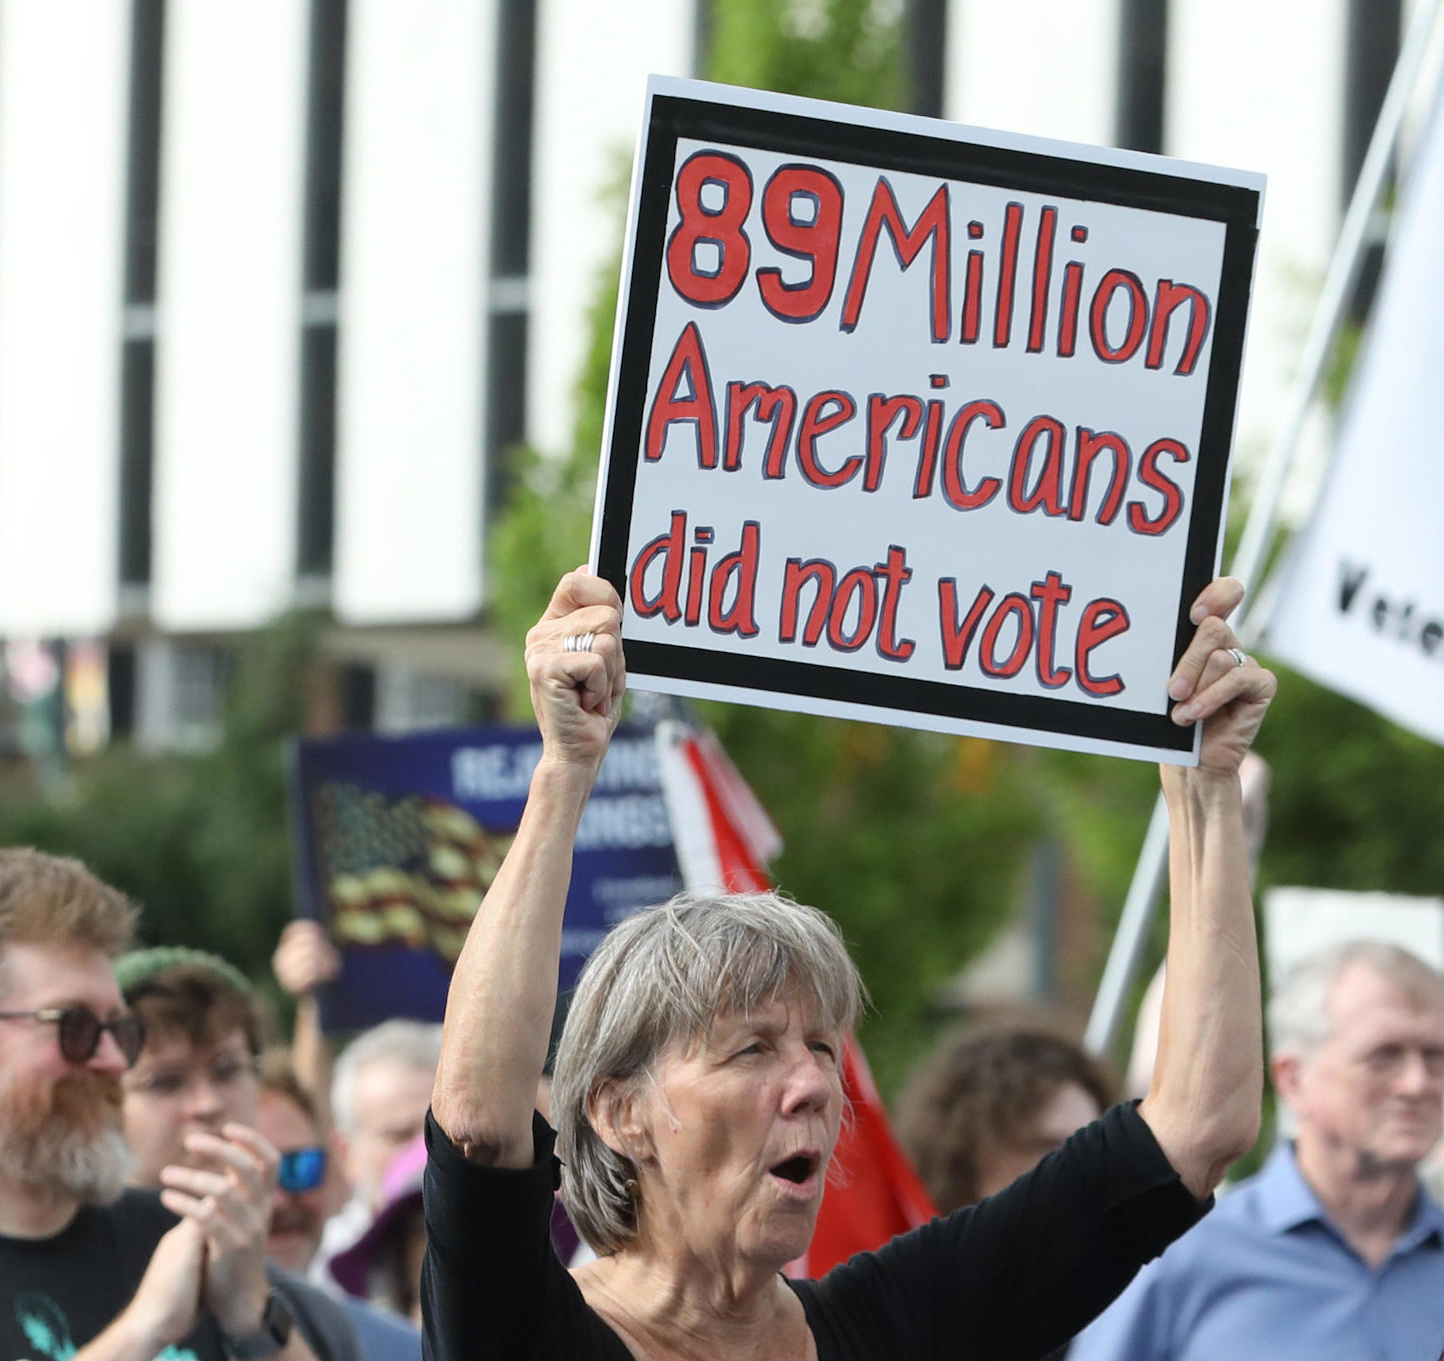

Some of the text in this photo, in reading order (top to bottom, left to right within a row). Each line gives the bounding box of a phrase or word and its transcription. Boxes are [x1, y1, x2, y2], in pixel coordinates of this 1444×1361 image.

[666, 148, 1211, 376] 89 Million
[645, 320, 1191, 537] Americans
[629, 510, 1132, 698] did not vote
